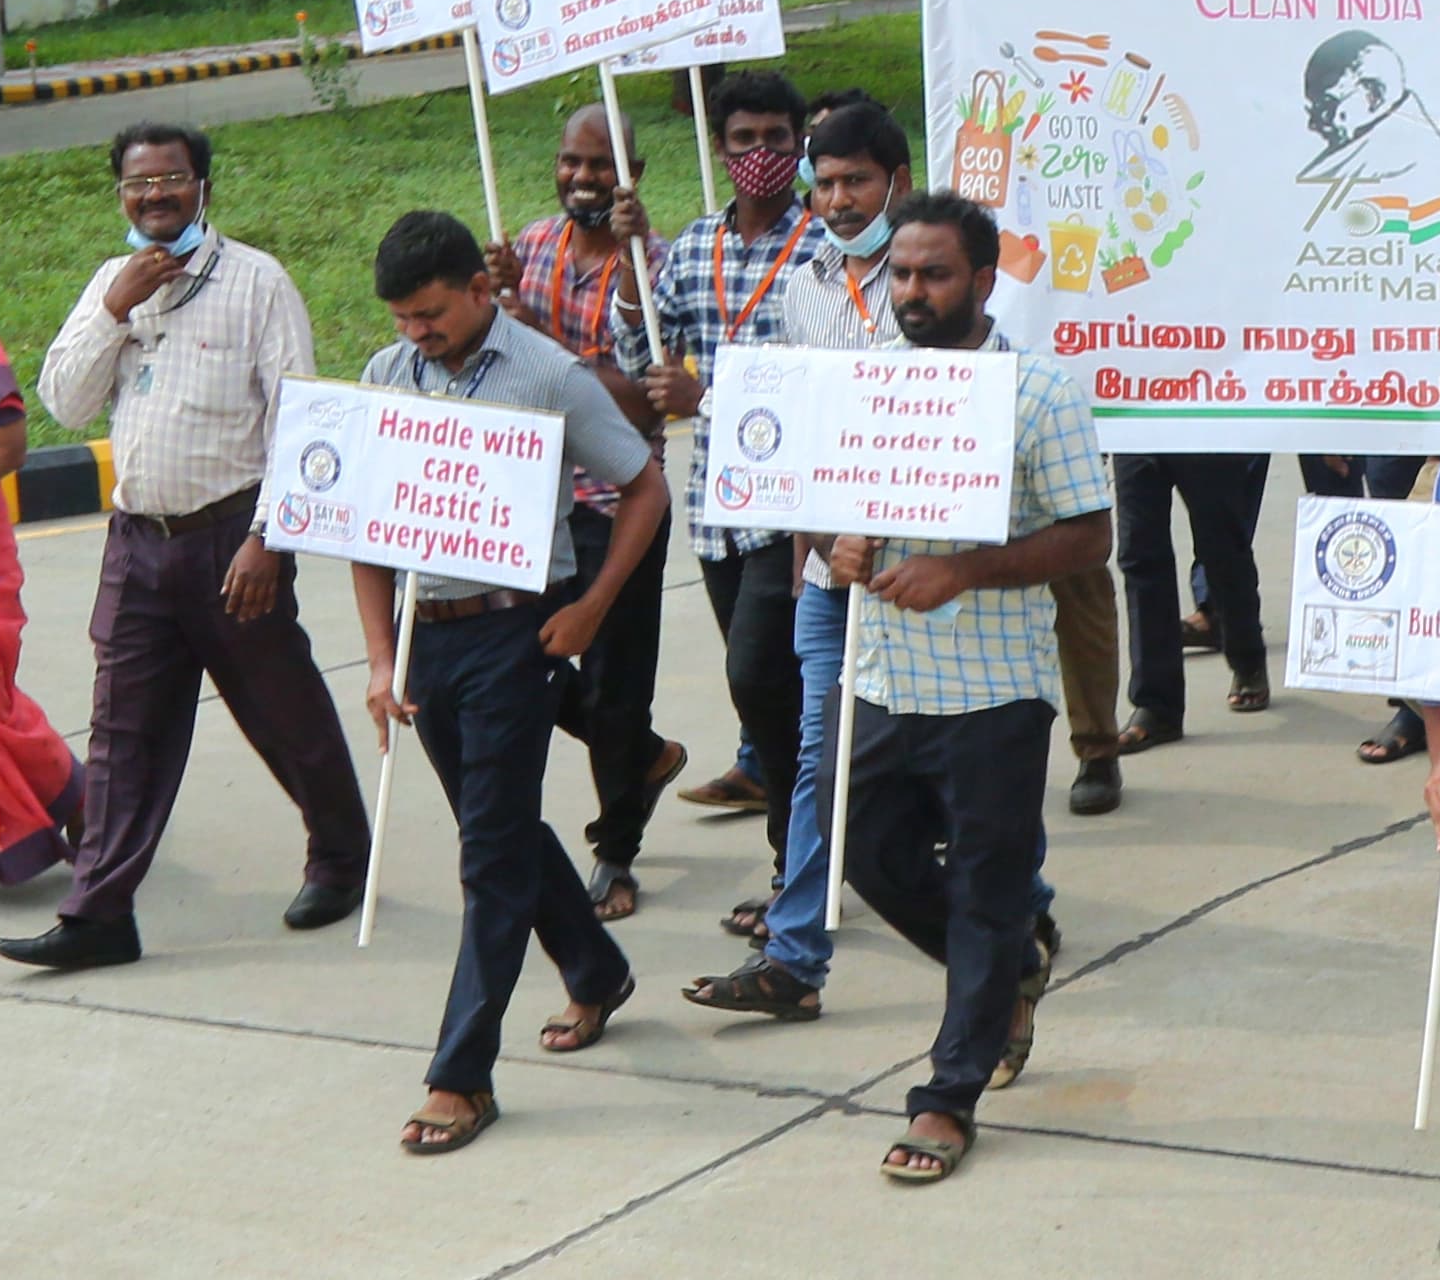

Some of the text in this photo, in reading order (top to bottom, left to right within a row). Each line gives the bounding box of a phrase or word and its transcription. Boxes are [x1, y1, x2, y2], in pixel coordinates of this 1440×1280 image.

[1048, 115, 1099, 140] GO TO
[1041, 144, 1109, 178] Zero
[959, 173, 1000, 201] BAG
[1047, 184, 1104, 210] WASTE
[1296, 239, 1404, 267] Azadi
[1283, 271, 1374, 293] Amrit
[1052, 313, 1227, 356] தூய்மை
[1242, 325, 1355, 360] நமது
[851, 360, 973, 384] Say no to
[1093, 367, 1247, 403] பேணிக்
[377, 407, 544, 461] Handle with
[839, 429, 977, 453] in order to
[422, 456, 487, 494] care,
[756, 475, 795, 493] SAY NO
[812, 464, 1001, 492] make Lifespan
[394, 481, 512, 529] Plastic is
[366, 519, 534, 570] everywhere.
